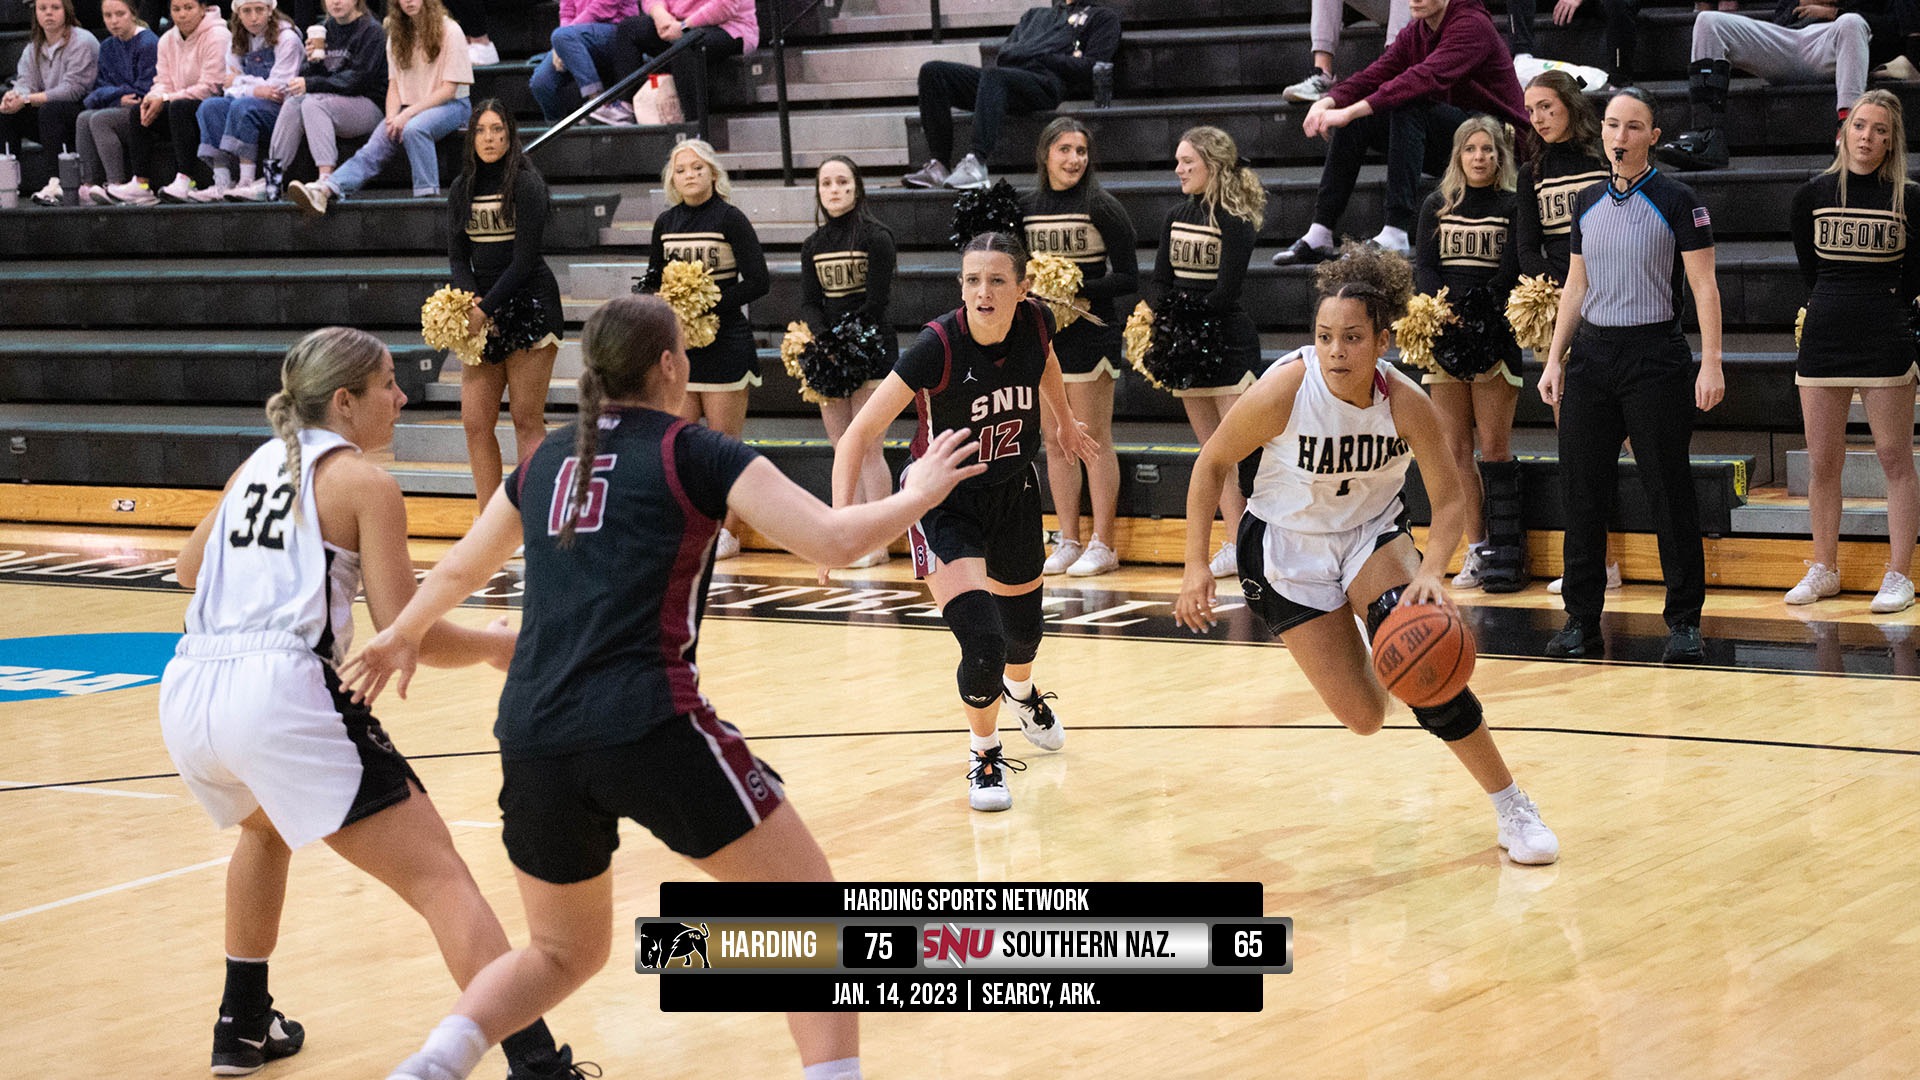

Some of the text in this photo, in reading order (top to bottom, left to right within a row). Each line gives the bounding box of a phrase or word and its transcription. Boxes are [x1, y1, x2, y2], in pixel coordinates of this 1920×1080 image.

[1026, 228, 1088, 252] ISONS
[1442, 230, 1507, 256] ISONS
[1819, 219, 1900, 251] BISONS
[1171, 239, 1218, 266] SONS
[818, 262, 867, 287] ISONS
[971, 386, 1032, 422] SNU
[979, 419, 1023, 463] 12
[548, 453, 618, 537] 15
[229, 483, 297, 551] 32
